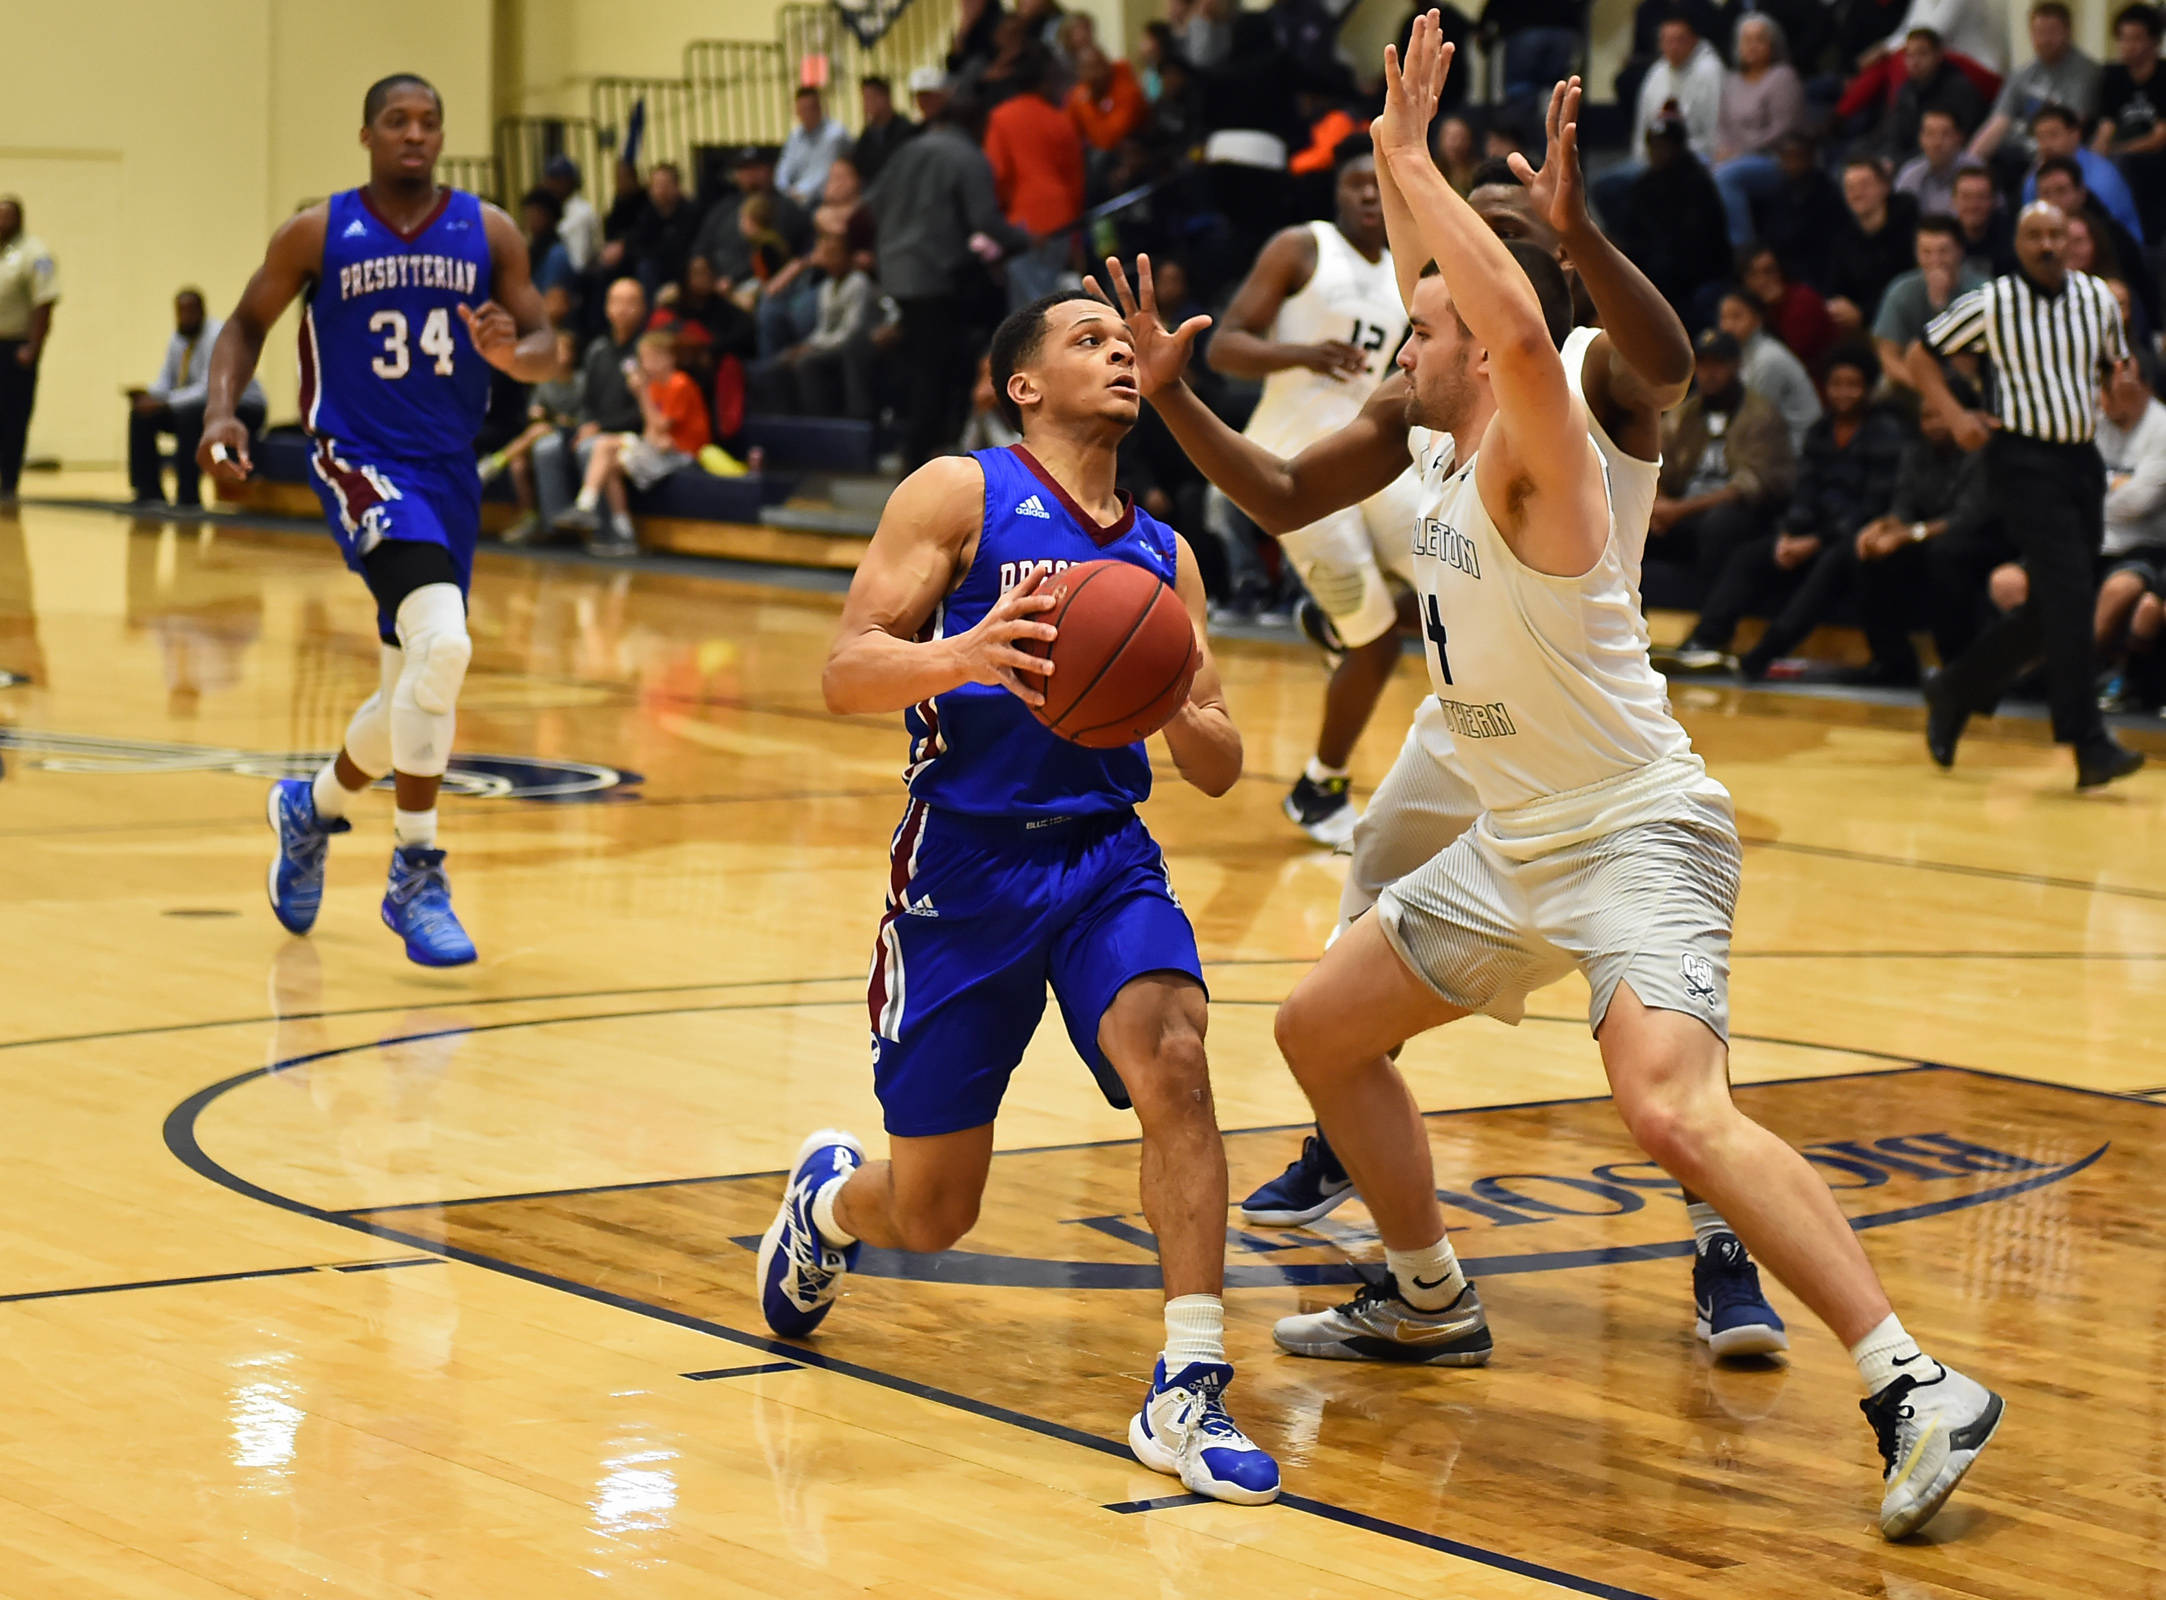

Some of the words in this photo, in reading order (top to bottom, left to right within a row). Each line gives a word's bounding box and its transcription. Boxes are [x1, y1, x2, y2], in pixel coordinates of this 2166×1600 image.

[340, 254, 477, 300] PRESBYTERIAN
[369, 307, 455, 379] 34
[1015, 506, 1050, 520] adidas
